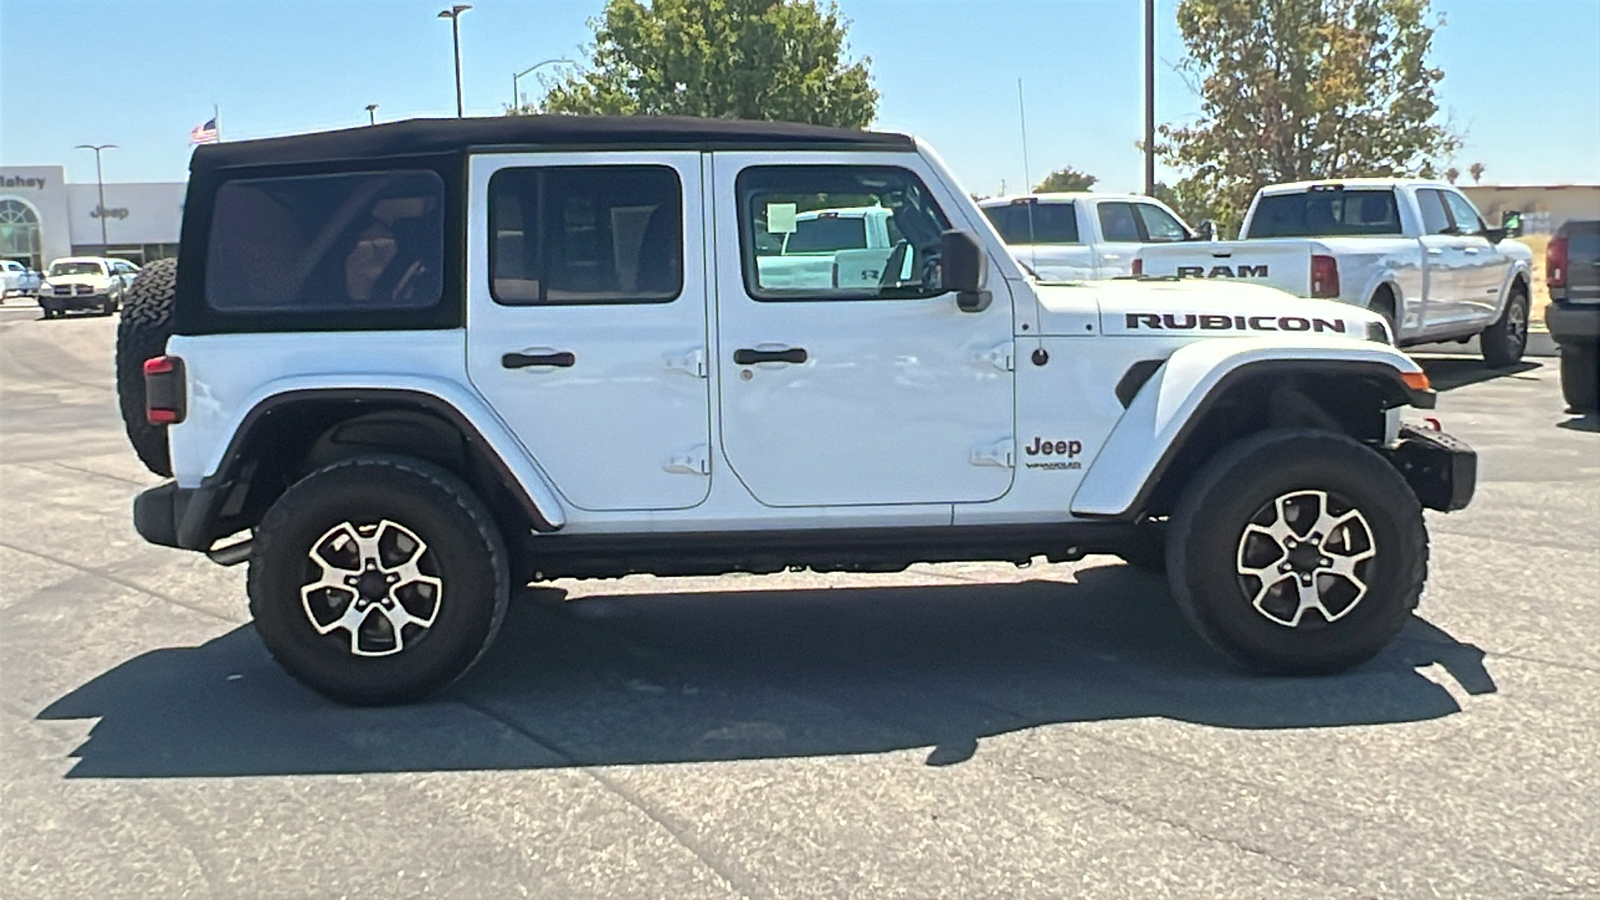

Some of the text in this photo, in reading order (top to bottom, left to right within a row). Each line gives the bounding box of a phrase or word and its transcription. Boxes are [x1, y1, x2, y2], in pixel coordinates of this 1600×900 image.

[1177, 265, 1269, 279] RAM
[1125, 312, 1346, 334] RUBICON
[1025, 436, 1082, 458] Jeep
